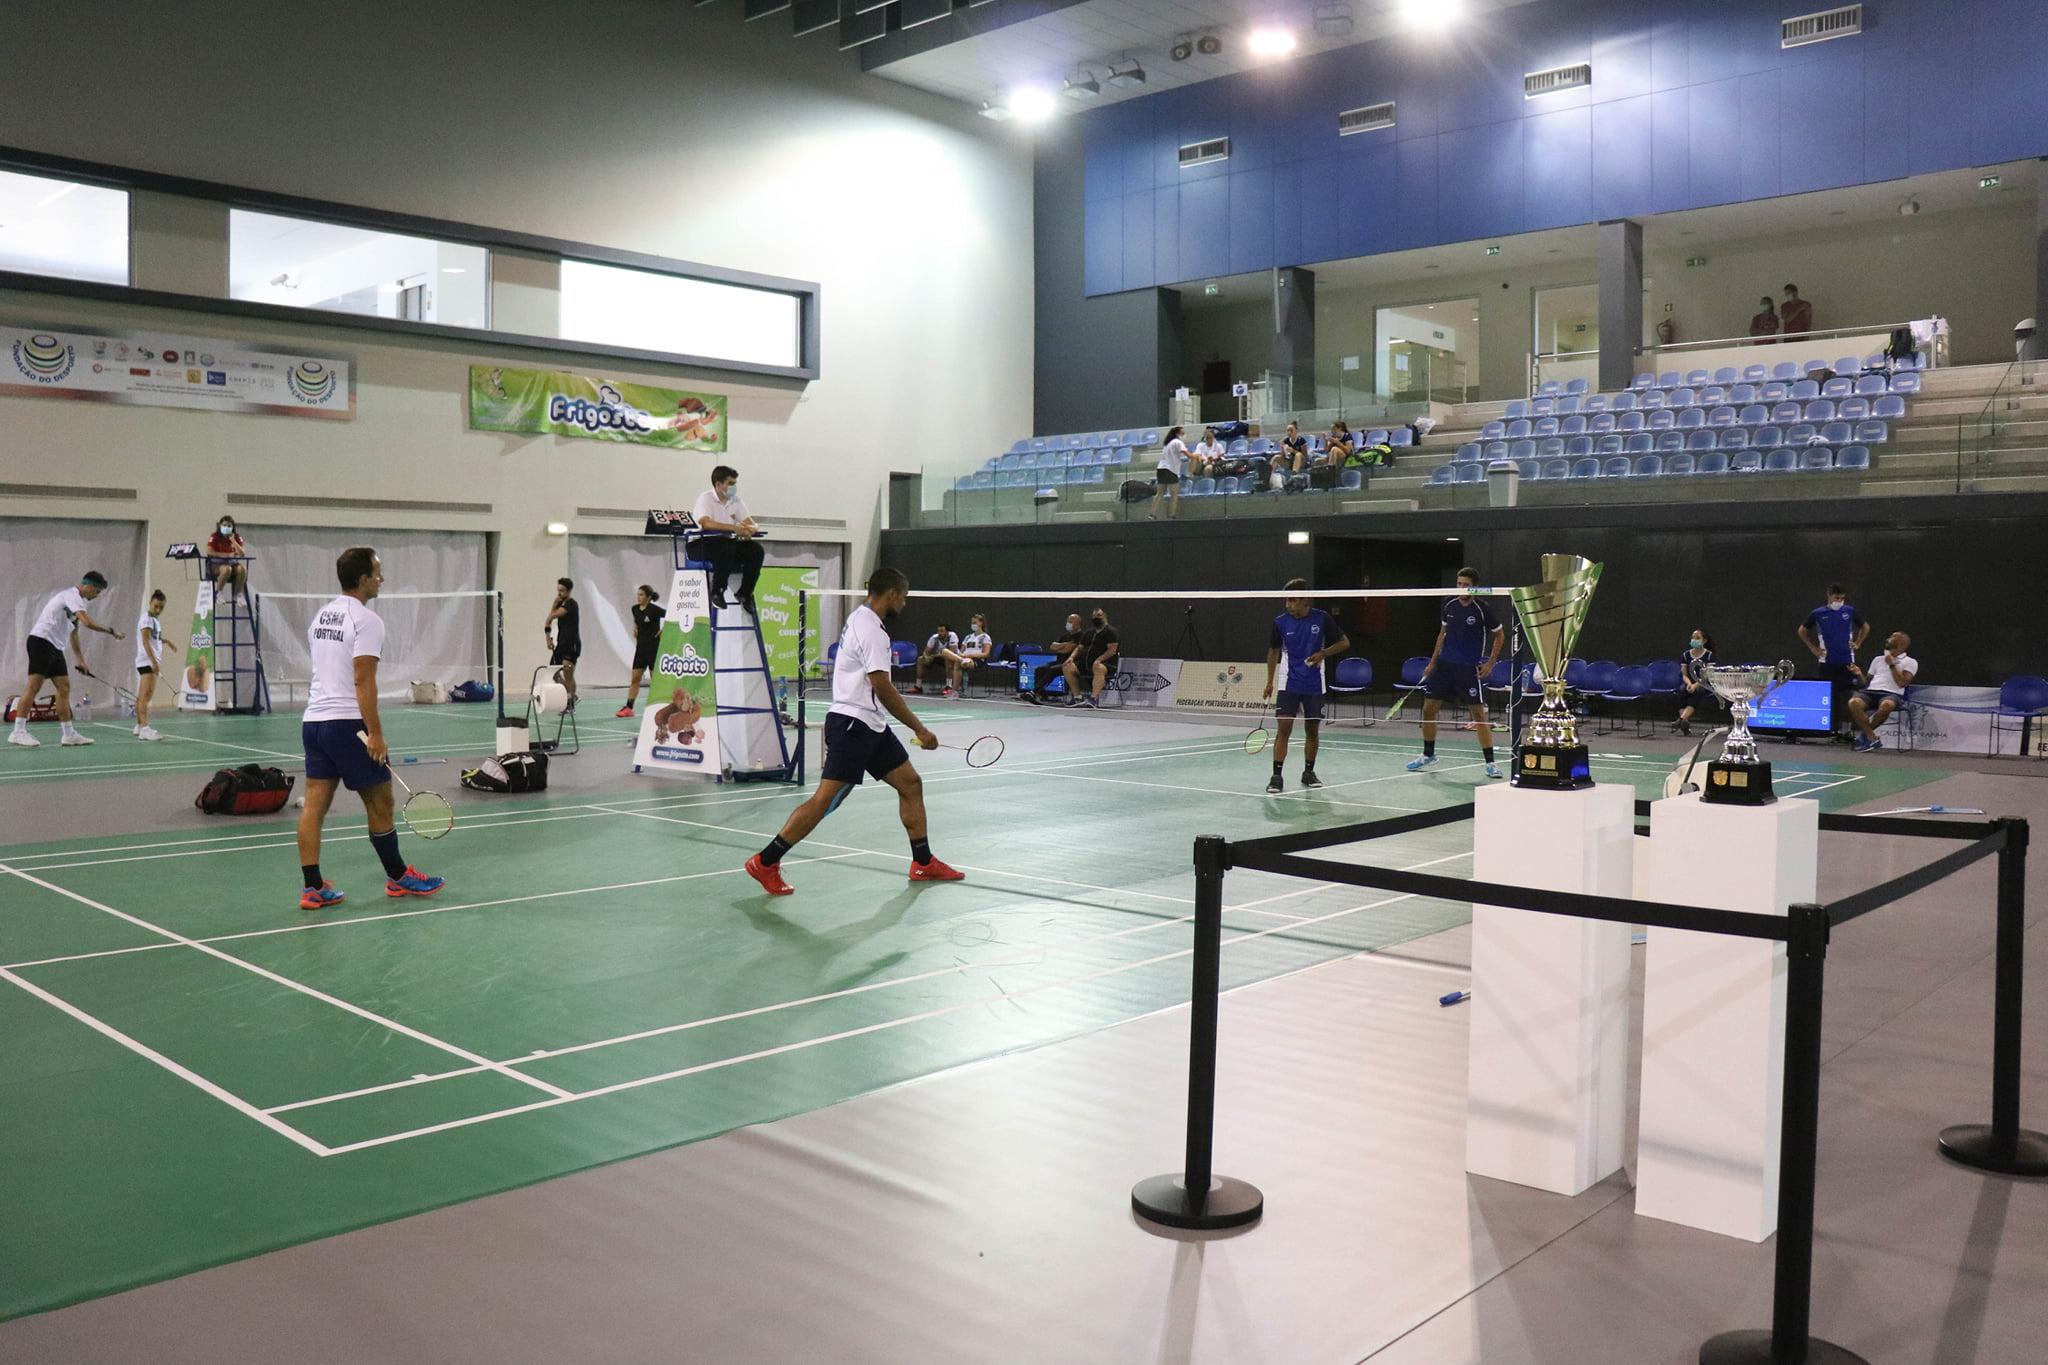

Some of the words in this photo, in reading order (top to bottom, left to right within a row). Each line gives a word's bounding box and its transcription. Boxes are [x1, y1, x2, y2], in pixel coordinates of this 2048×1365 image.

[54, 344, 75, 381] DESPORTO
[761, 606, 790, 626] play
[314, 627, 345, 642] PORTUGAL
[779, 628, 817, 638] courge
[660, 655, 708, 677] Frigosto
[1176, 698, 1205, 708] FEDERAÇÃO
[1205, 699, 1237, 708] PORTUGUESA
[1821, 696, 1829, 706] 8
[1821, 716, 1829, 725] 8
